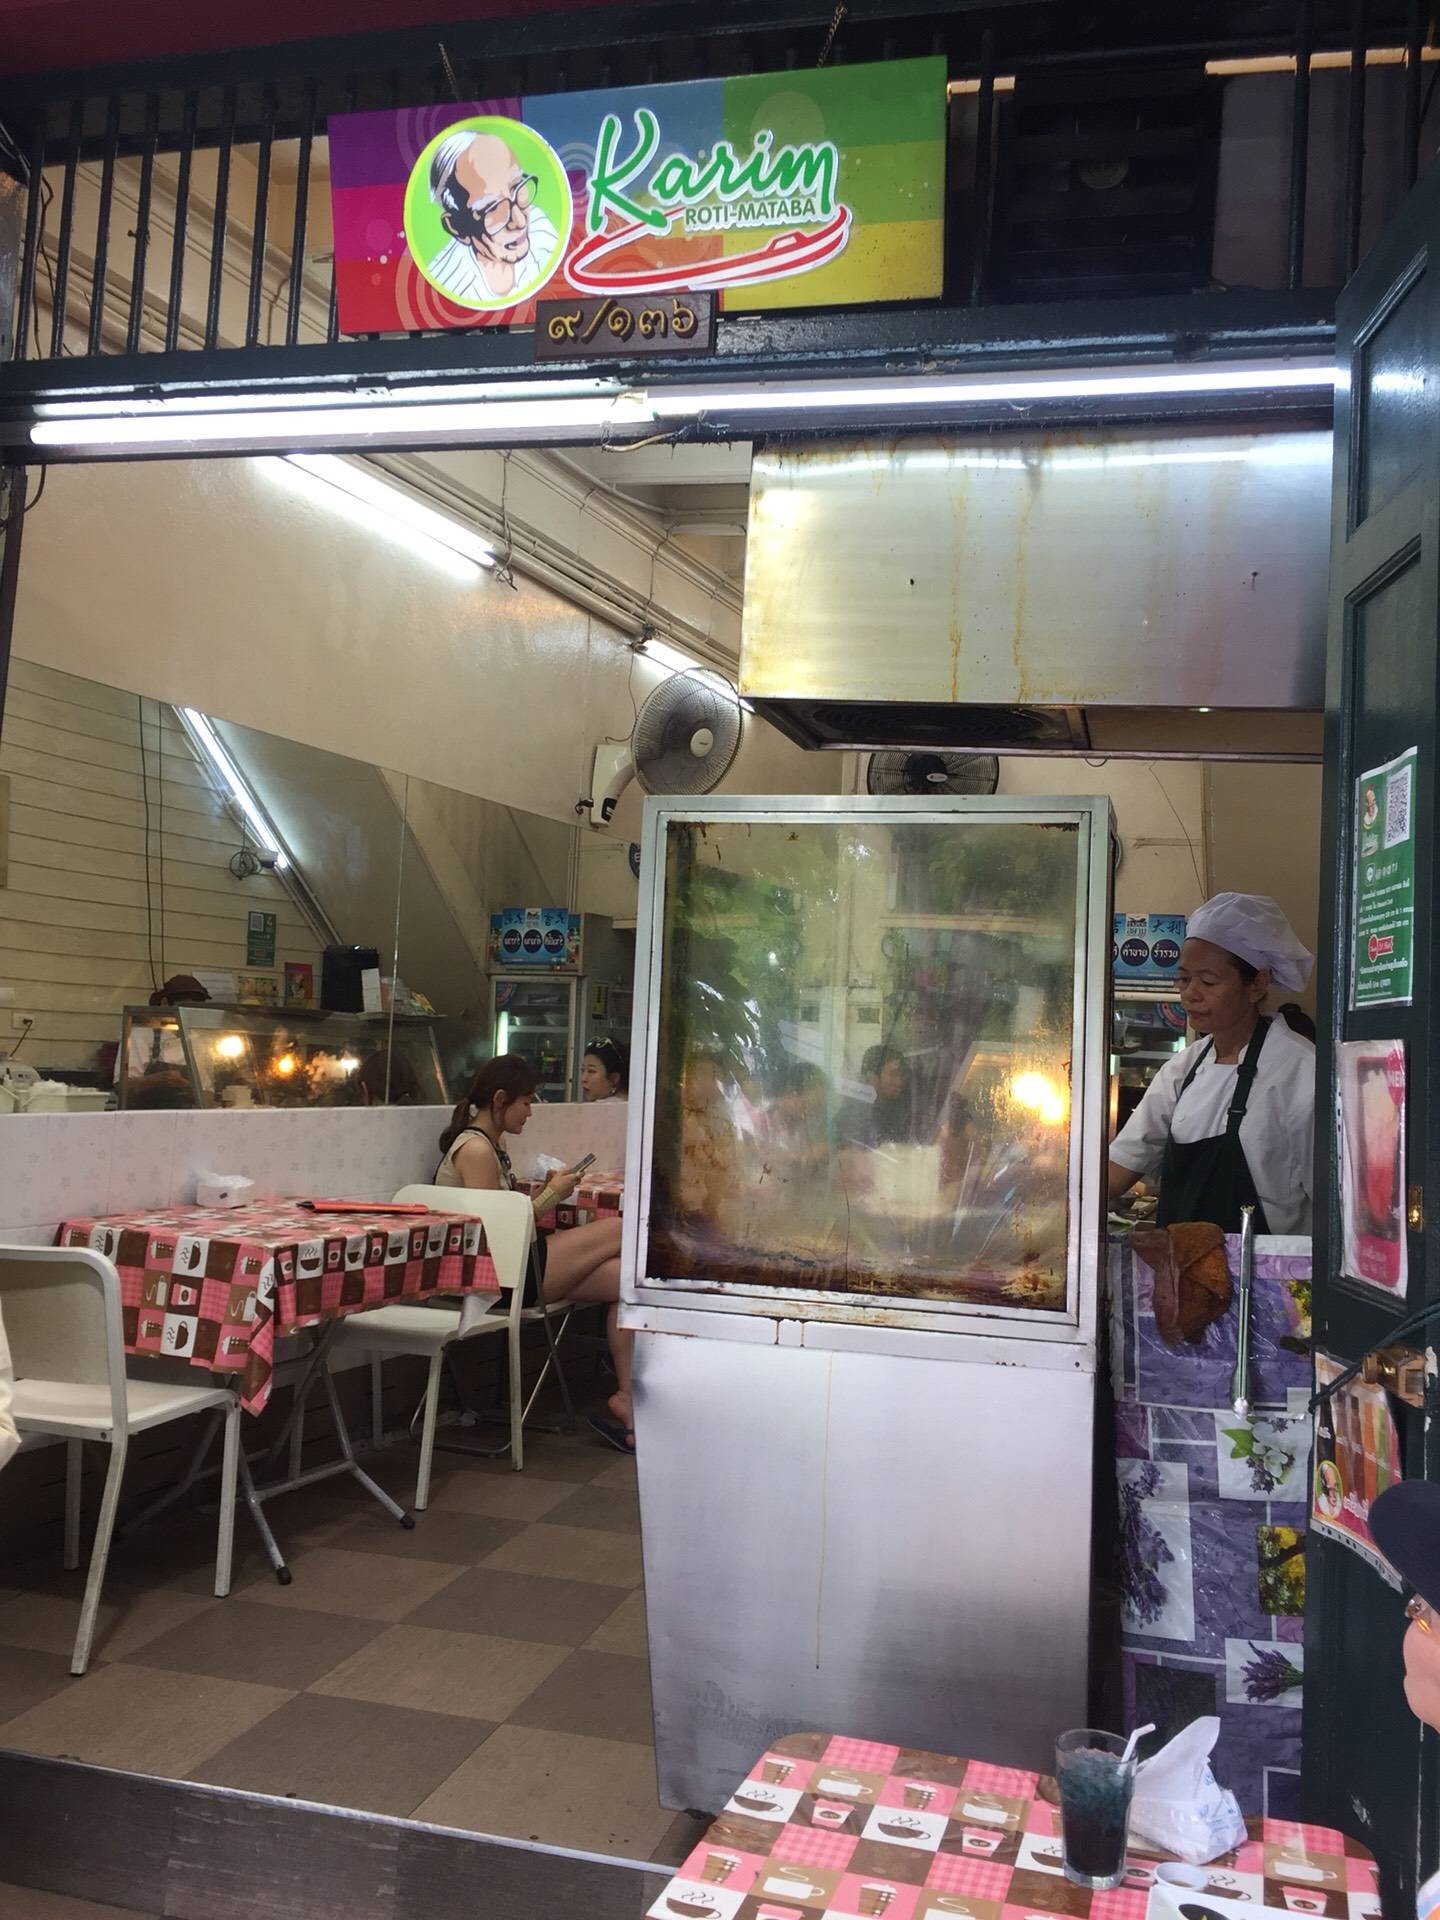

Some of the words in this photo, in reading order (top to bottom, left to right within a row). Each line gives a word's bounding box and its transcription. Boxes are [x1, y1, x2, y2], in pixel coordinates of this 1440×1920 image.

[588, 109, 838, 233] Karim
[684, 197, 816, 226] ROTI-MATABA
[547, 297, 695, 339] ๙/๑๓๖
[1122, 943, 1148, 957] ค้าขาย
